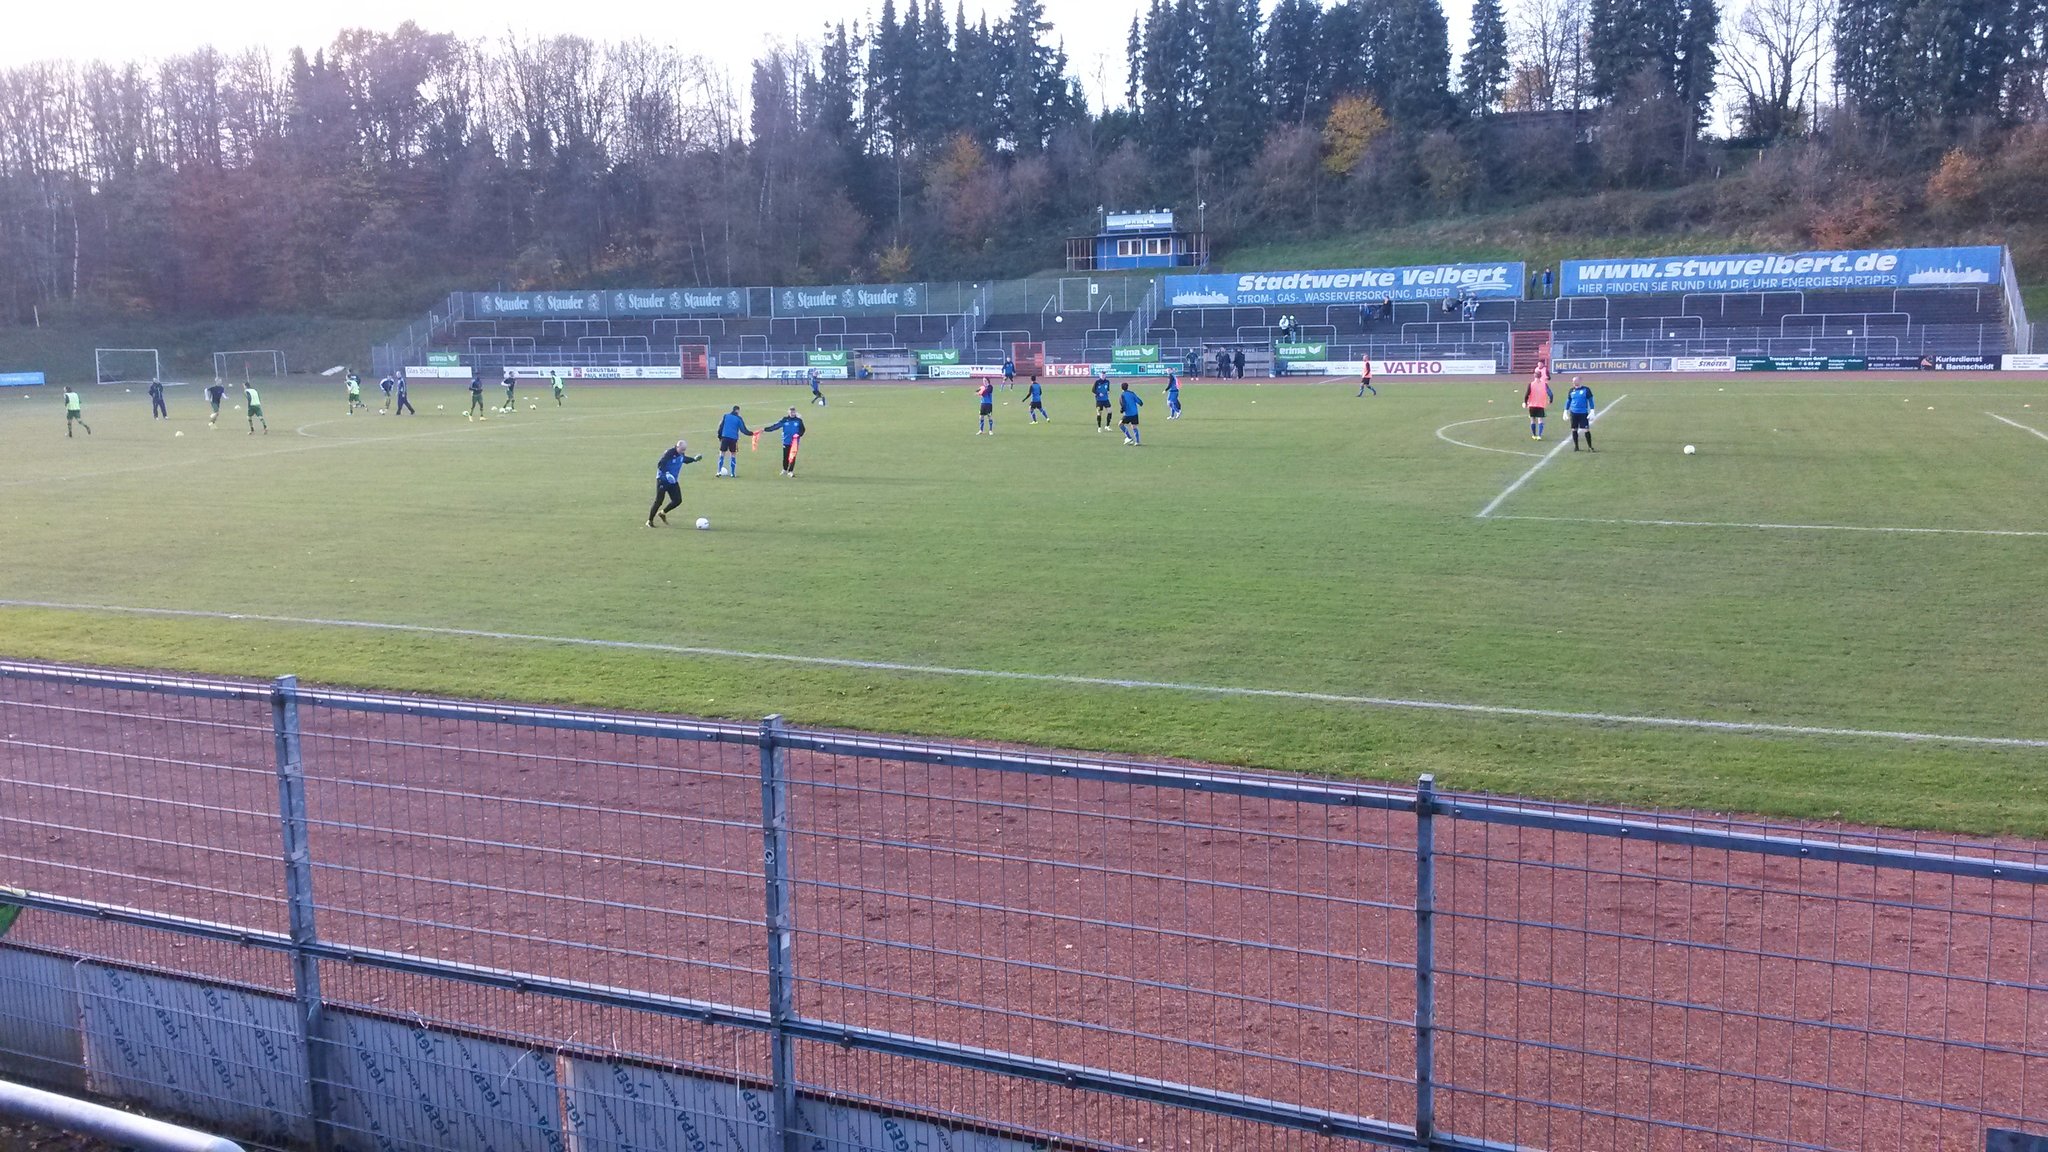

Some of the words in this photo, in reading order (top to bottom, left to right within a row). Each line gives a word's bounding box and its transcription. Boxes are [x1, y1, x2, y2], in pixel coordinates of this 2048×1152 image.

[1579, 253, 1897, 280] www.stwvelbert.de
[1237, 271, 1396, 291] Stadtwerke
[1402, 267, 1508, 286] Velbert
[1577, 283, 1602, 293] HIER
[1606, 282, 1648, 292] FINDEN
[1652, 281, 1668, 291] SIE
[1671, 280, 1704, 290] RUND
[1708, 279, 1727, 289] UM
[1731, 278, 1749, 288] DIE
[1753, 277, 1778, 288] UHR
[1782, 275, 1897, 288] ENERGIESPARTIPPS
[628, 293, 665, 309] Stauder
[684, 291, 722, 308] Stauder
[797, 291, 837, 308] Stauder
[858, 289, 899, 307] Stauder
[1416, 287, 1449, 298] BÄDER
[494, 296, 529, 311] Stauder
[547, 295, 583, 311] Stauder
[920, 352, 944, 360] erima
[1115, 347, 1140, 356] erima
[1279, 346, 1306, 355] erima
[1383, 361, 1442, 374] VATRO
[1555, 362, 1588, 370] METALL
[1590, 361, 1628, 369] DITTRICH
[676, 1110, 705, 1152] GEPA
